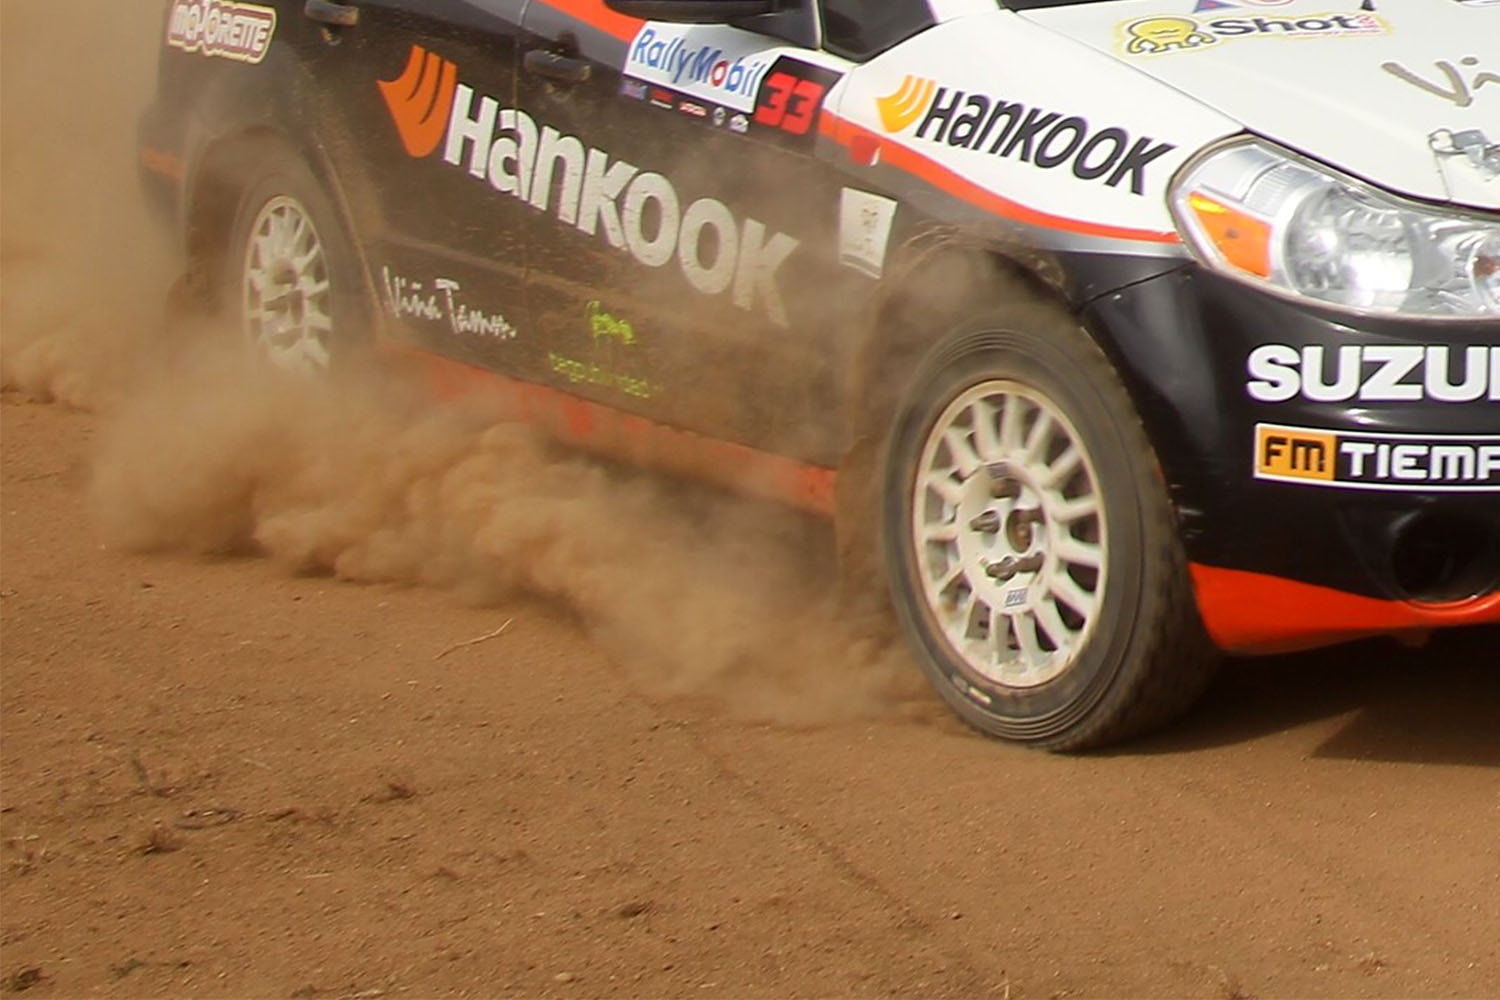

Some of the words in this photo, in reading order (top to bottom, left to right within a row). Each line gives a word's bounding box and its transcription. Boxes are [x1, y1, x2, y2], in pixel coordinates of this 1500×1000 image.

[1209, 14, 1359, 36] Shot
[754, 71, 825, 135] 33
[1263, 435, 1328, 473] FM
